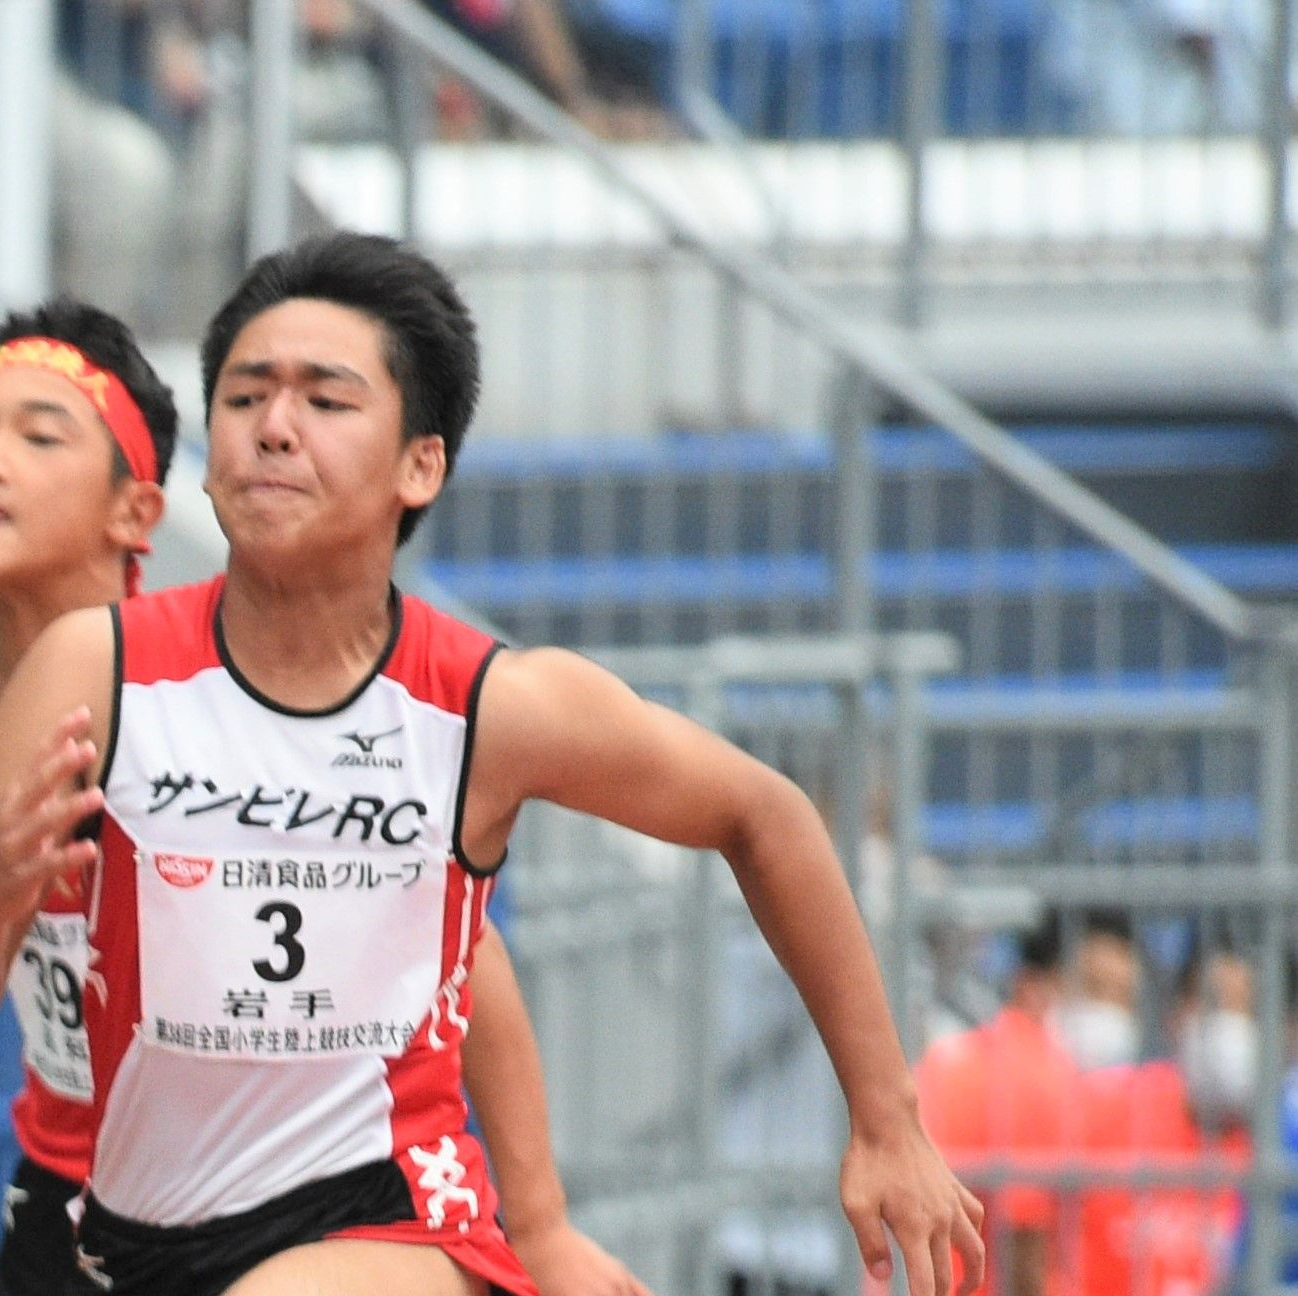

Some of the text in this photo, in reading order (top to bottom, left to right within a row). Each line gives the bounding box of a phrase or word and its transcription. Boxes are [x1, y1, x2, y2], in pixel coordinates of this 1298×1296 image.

[148, 770, 428, 846] サンビレRC
[251, 900, 306, 983] 3
[222, 988, 335, 1019] 岩手
